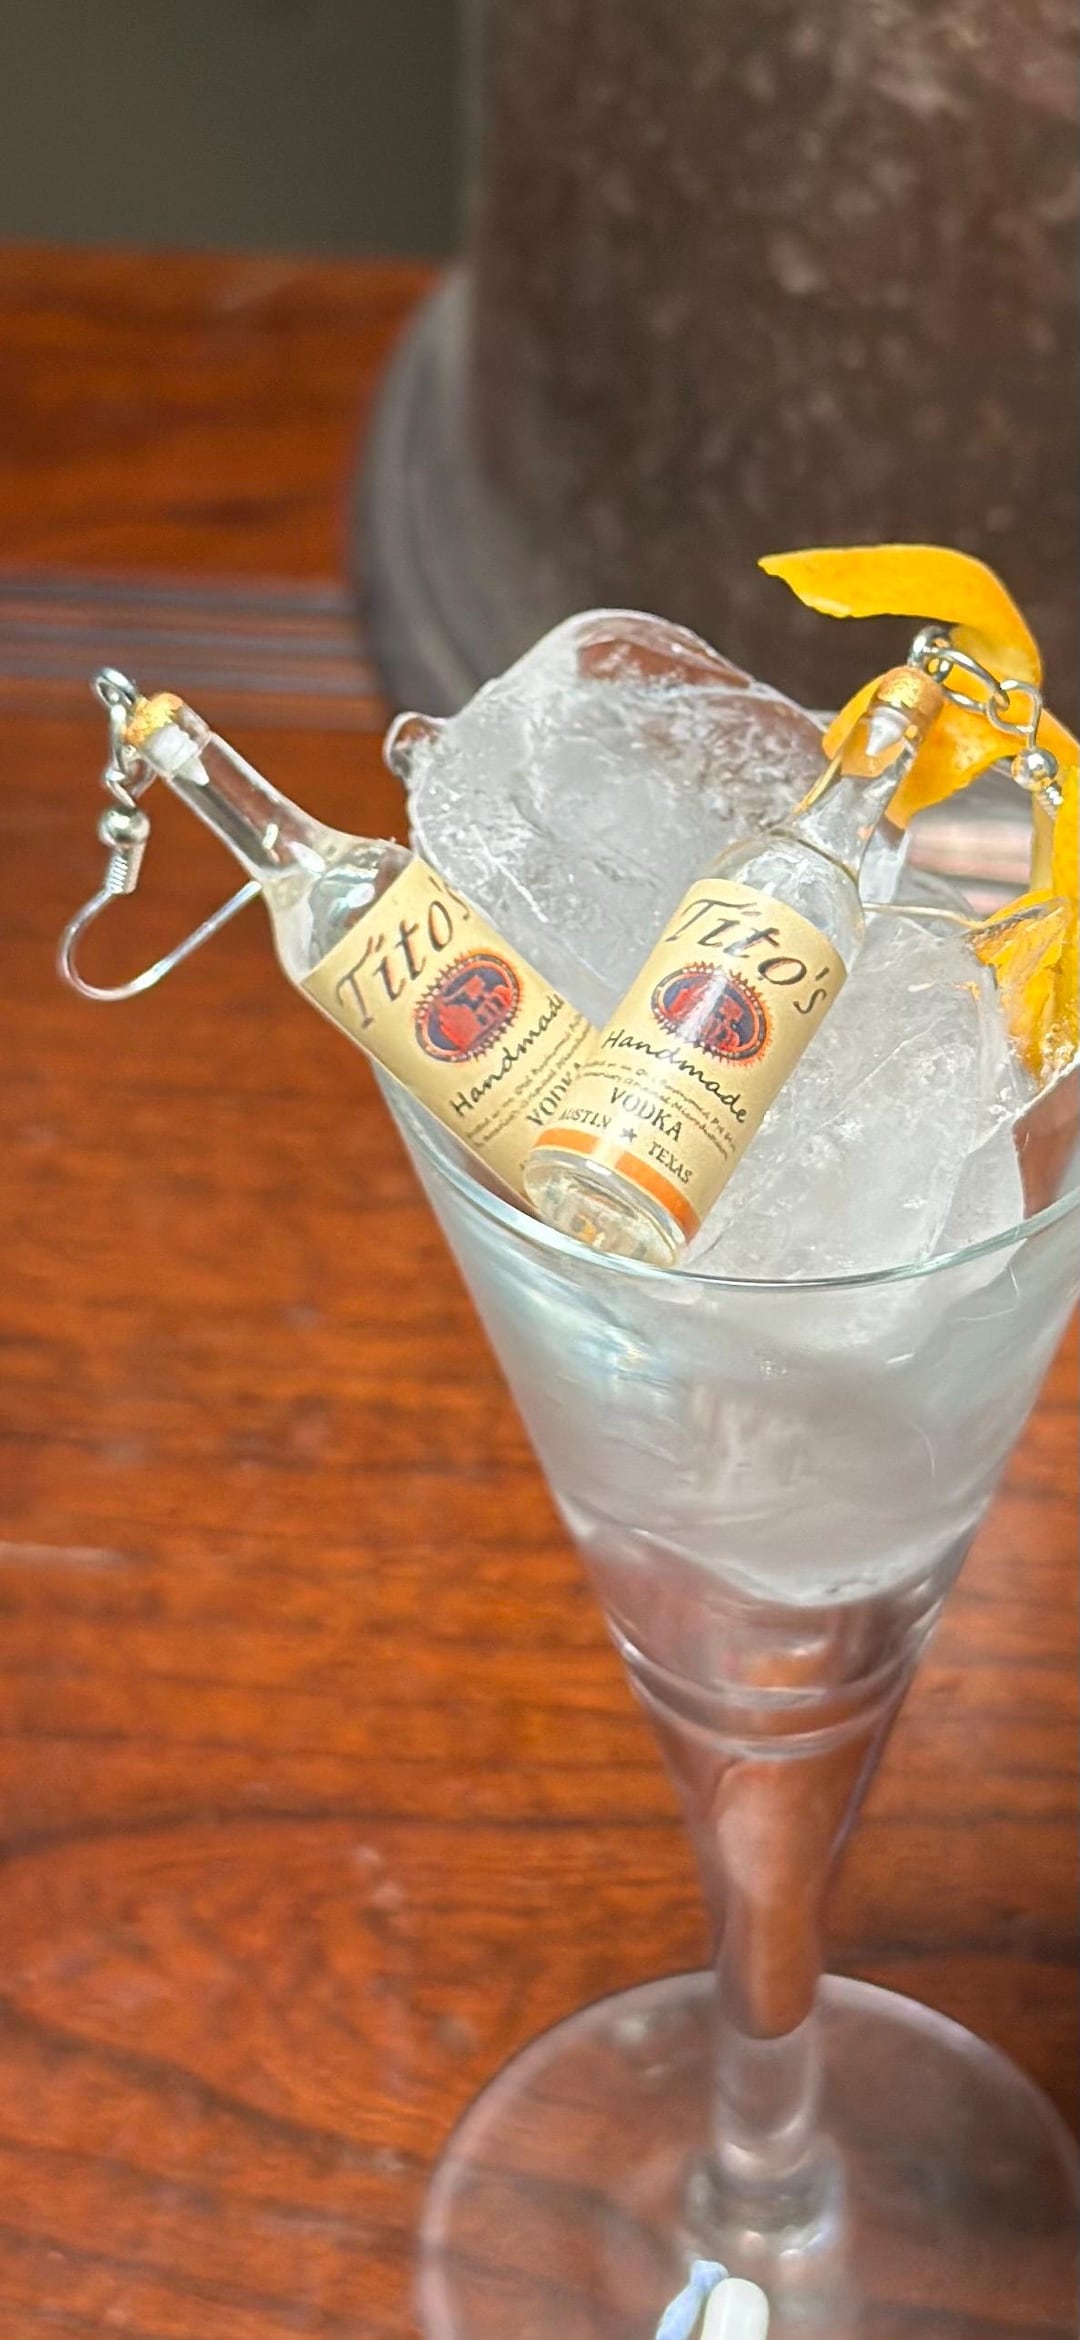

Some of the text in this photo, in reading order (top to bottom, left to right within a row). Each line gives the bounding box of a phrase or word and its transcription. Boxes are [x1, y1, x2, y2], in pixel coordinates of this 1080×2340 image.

[665, 897, 829, 1015] Tito's
[601, 1030, 748, 1124] Handmade
[609, 1086, 682, 1143] VODKA
[648, 1136, 694, 1185] TEXAS
